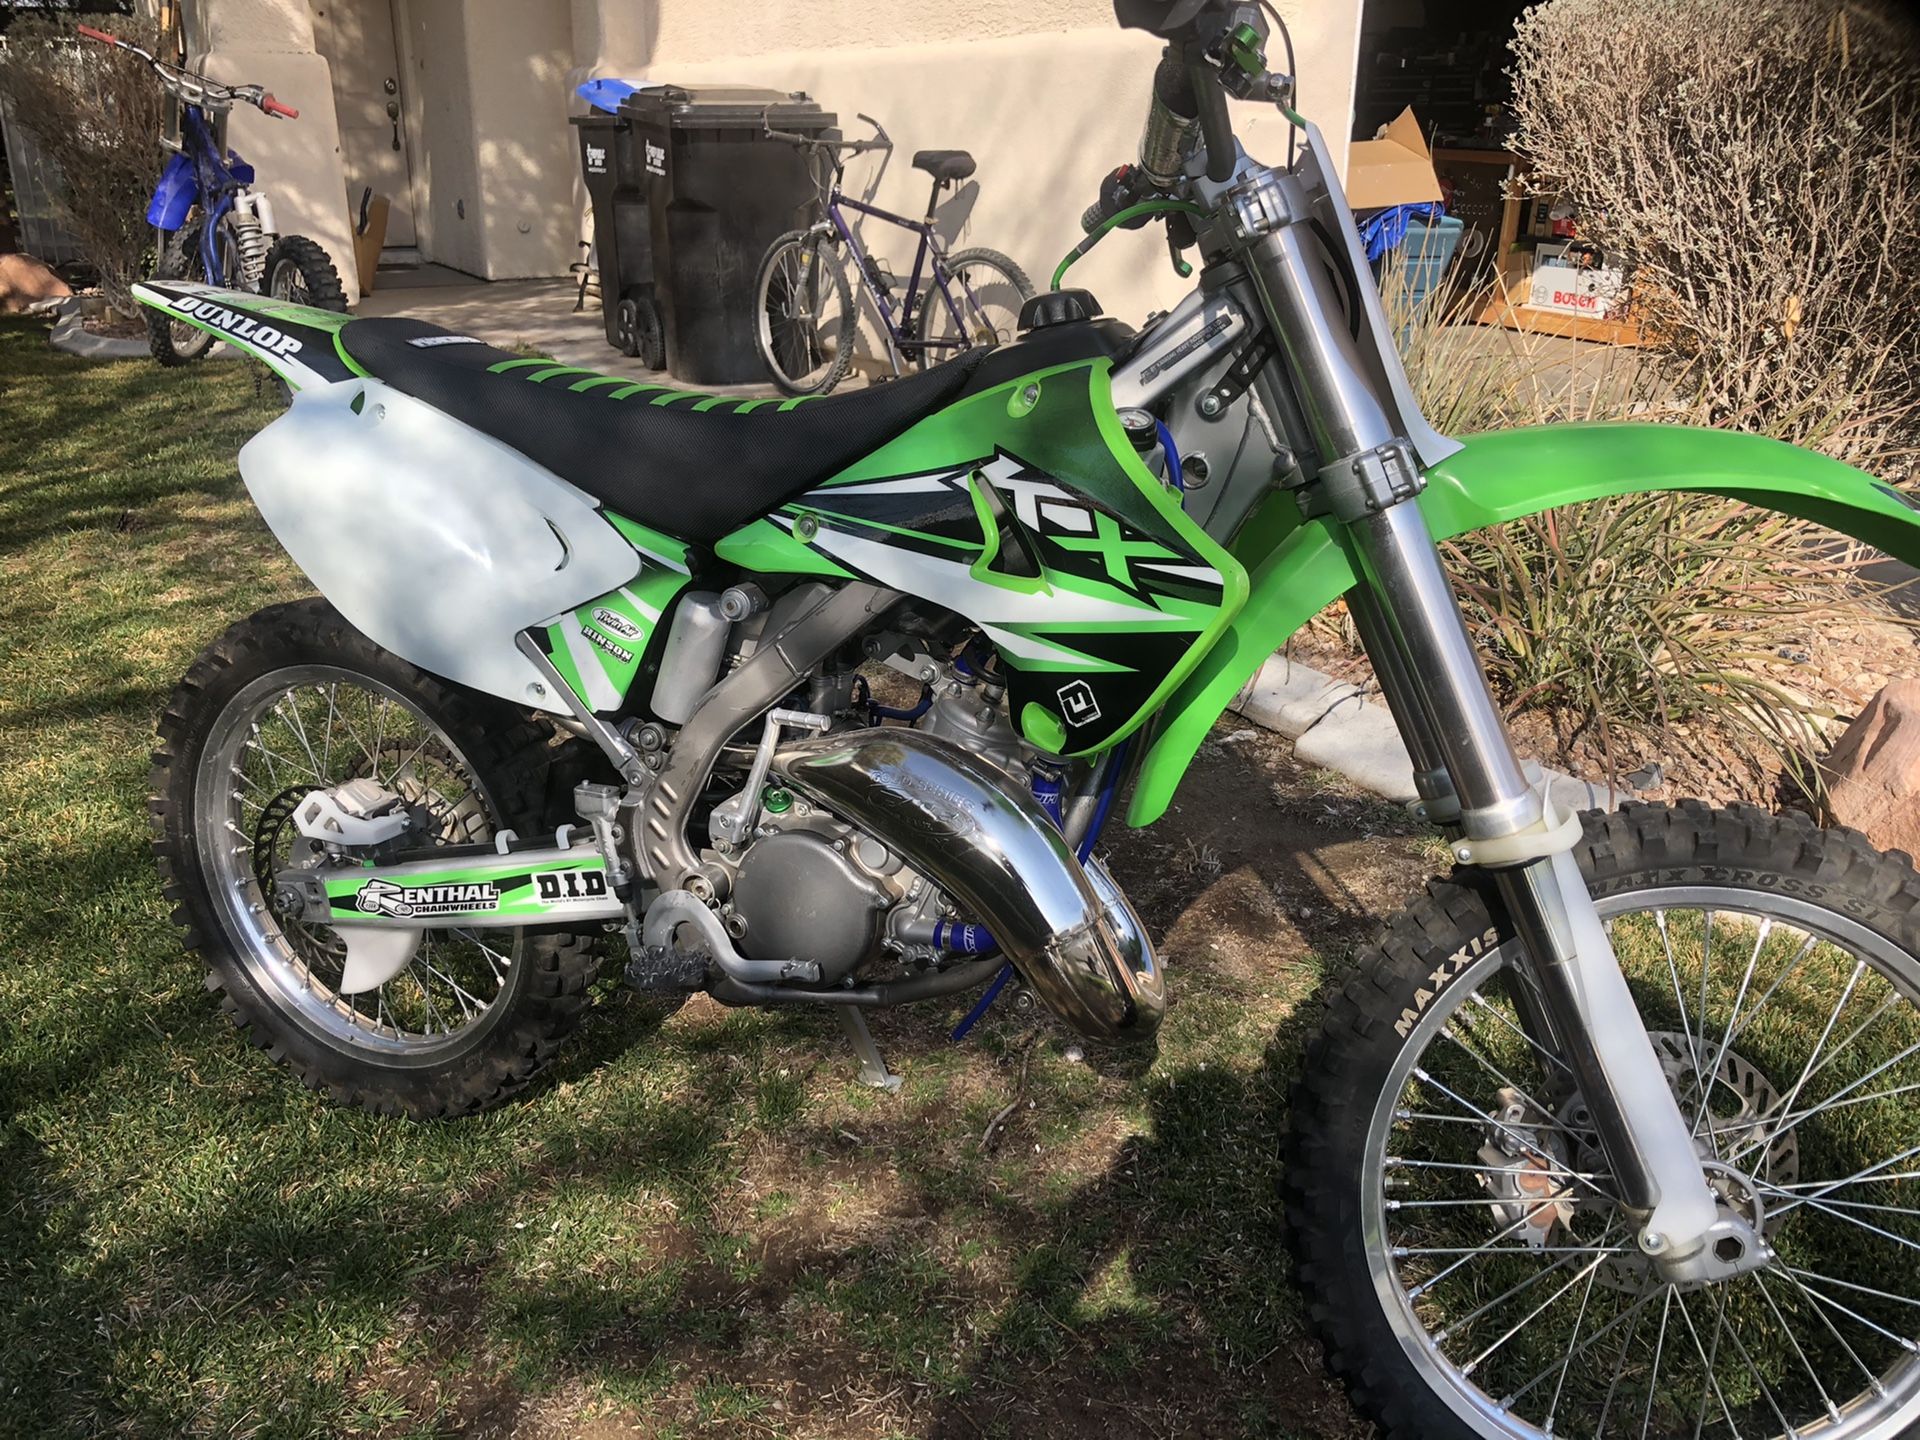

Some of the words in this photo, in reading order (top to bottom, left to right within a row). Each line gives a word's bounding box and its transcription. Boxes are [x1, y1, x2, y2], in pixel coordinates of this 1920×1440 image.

[170, 297, 303, 355] DUNLOP
[582, 626, 634, 660] HINSON
[358, 879, 498, 915] RENTHAL
[536, 871, 607, 899] D.I.D
[415, 901, 497, 914] CHAINWHEELS
[1394, 926, 1499, 1039] MAXXIS
